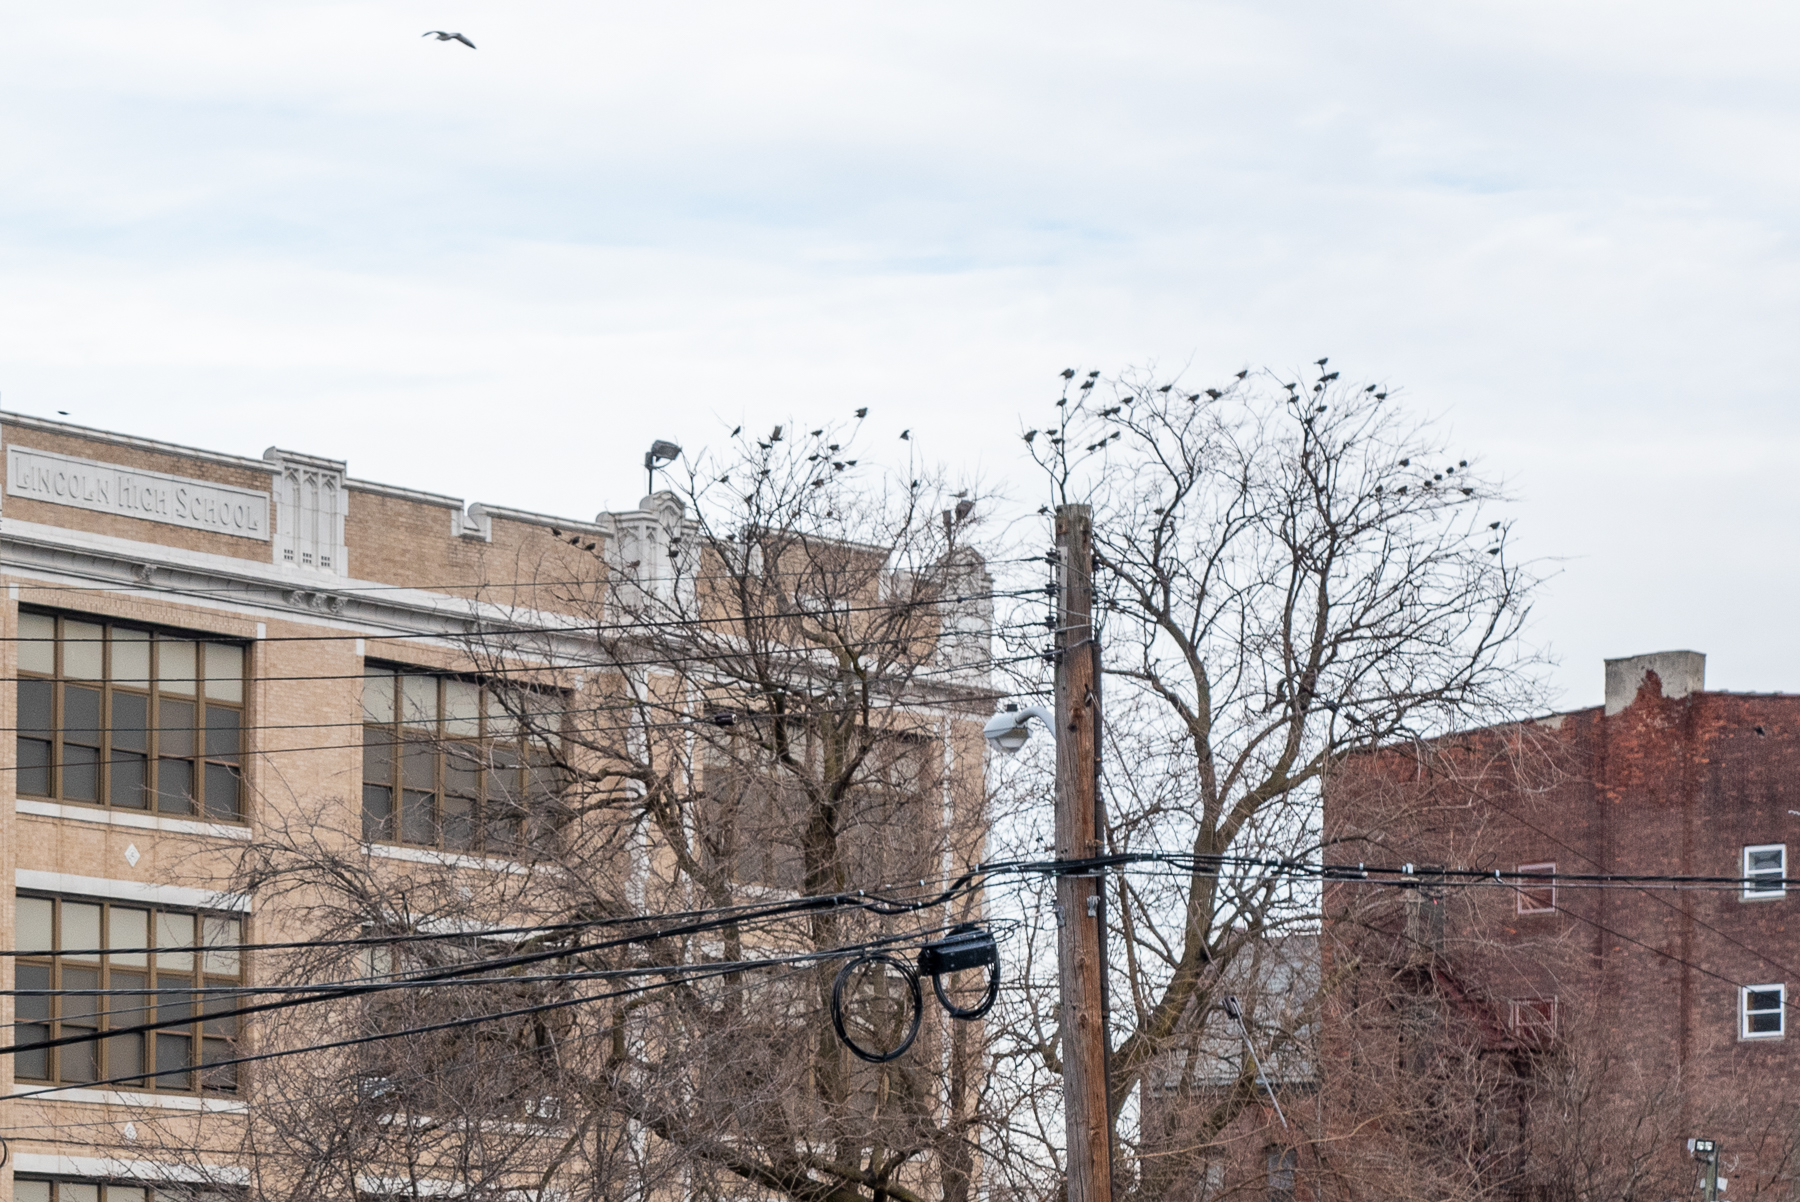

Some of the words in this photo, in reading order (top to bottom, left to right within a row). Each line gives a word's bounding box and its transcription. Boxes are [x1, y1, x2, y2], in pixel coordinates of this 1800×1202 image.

[14, 456, 110, 505] LINCOLN
[117, 476, 167, 515] HIGH
[175, 488, 258, 531] SCHOOL
